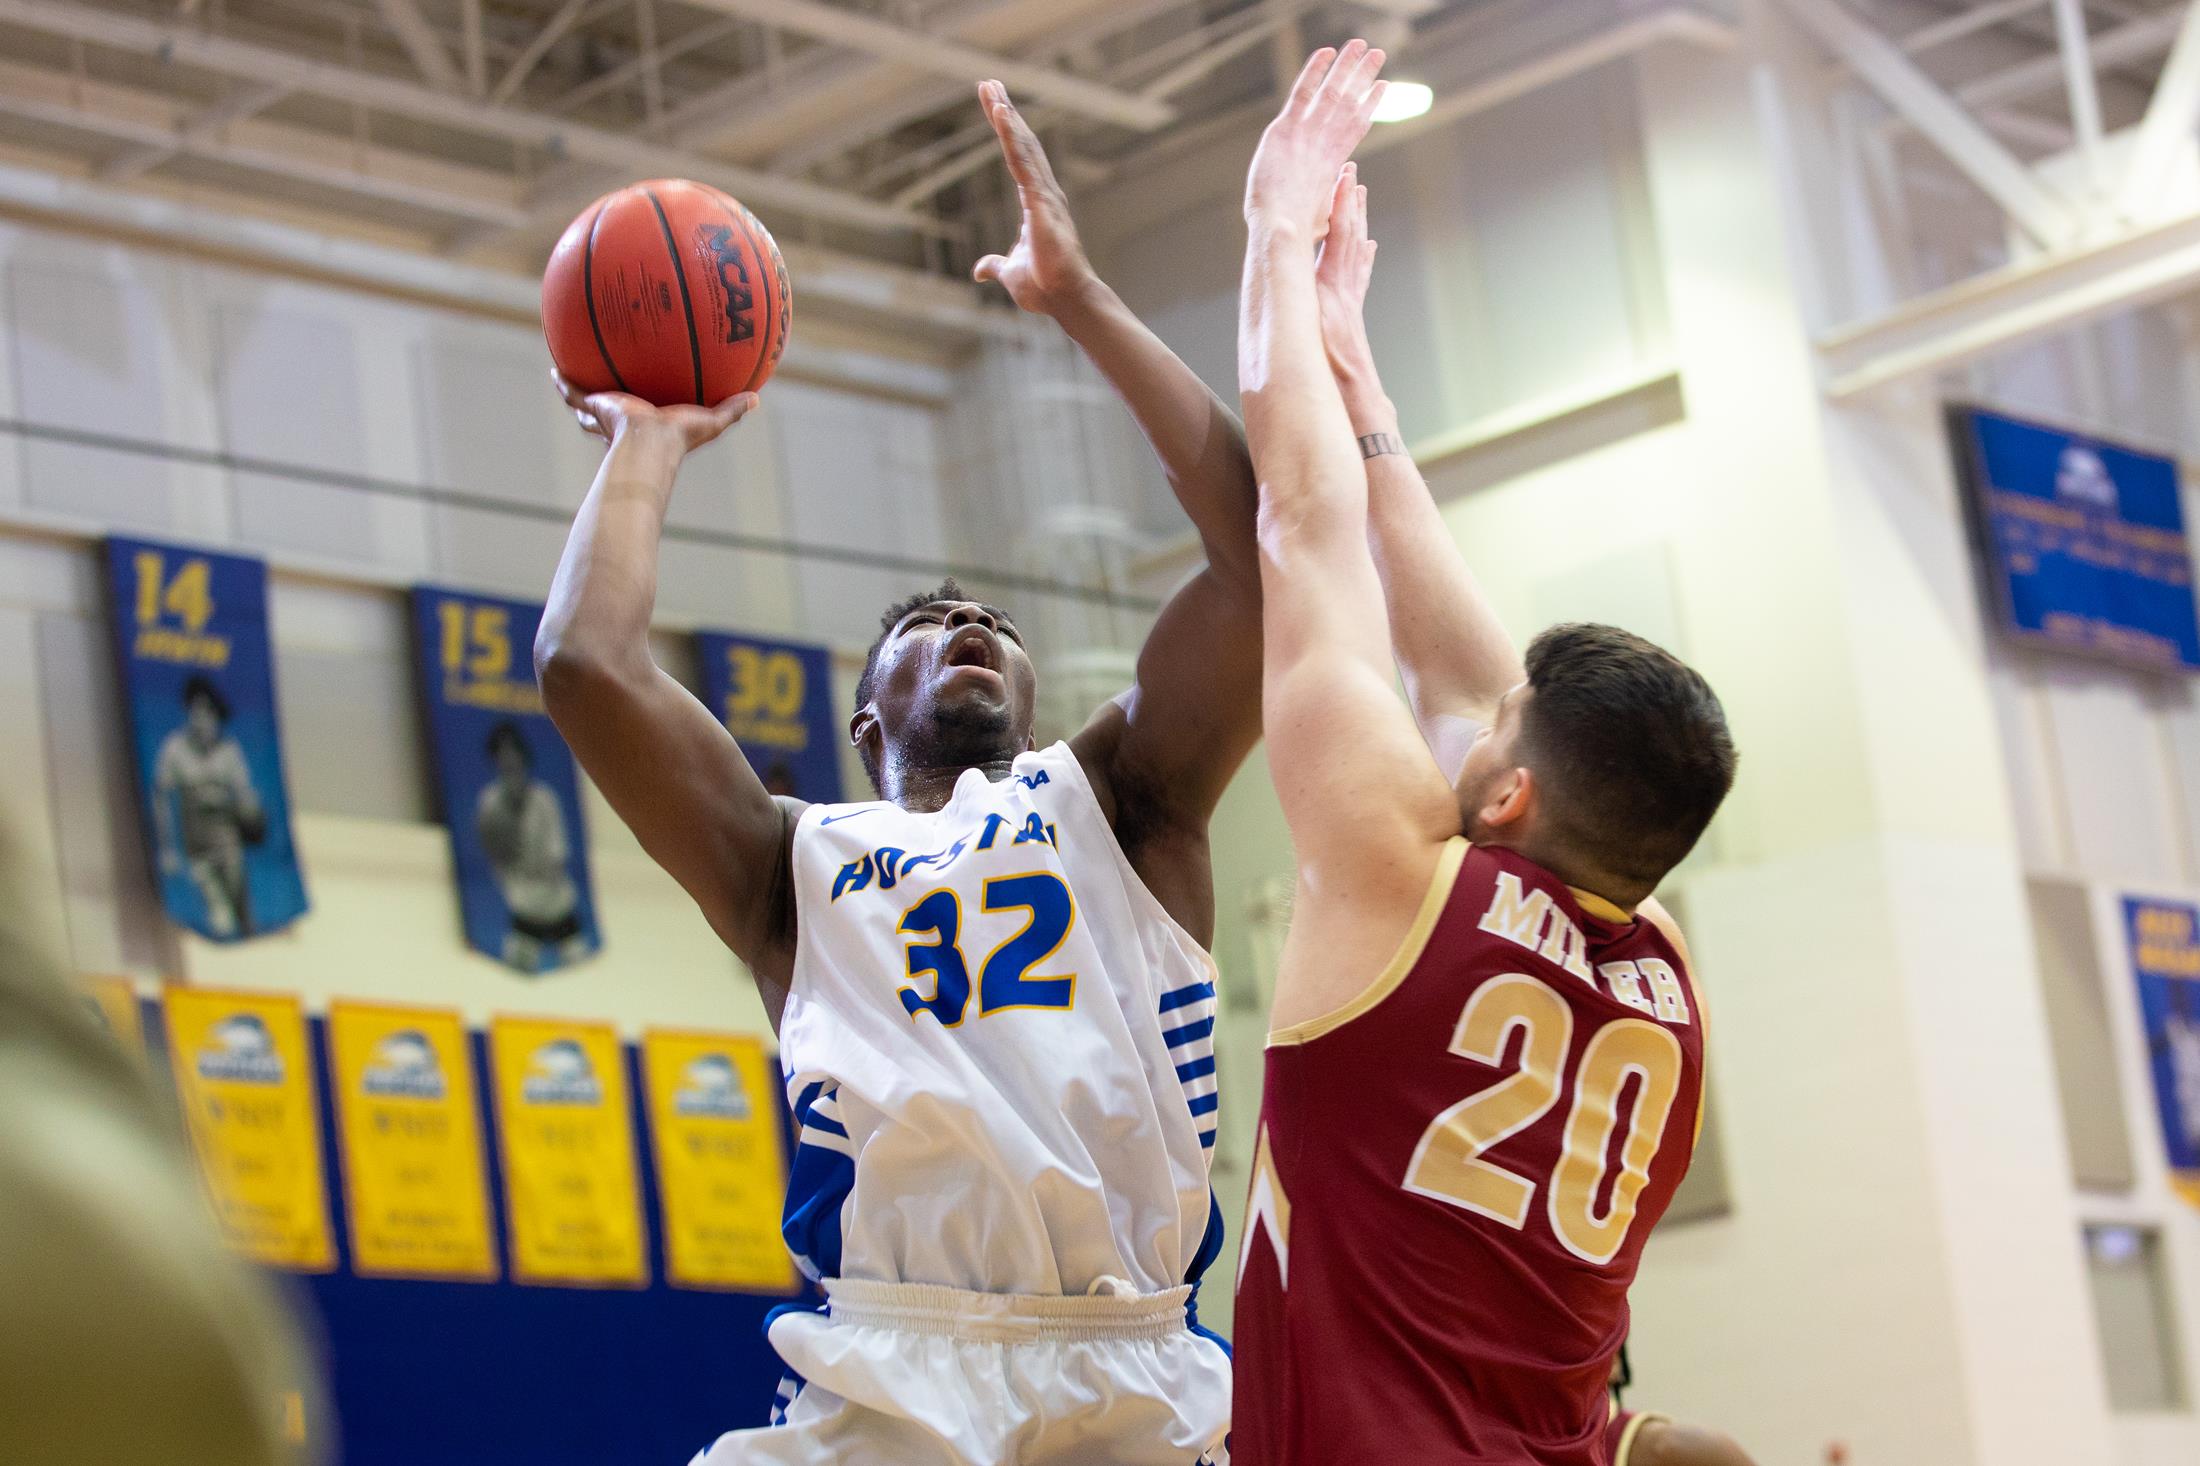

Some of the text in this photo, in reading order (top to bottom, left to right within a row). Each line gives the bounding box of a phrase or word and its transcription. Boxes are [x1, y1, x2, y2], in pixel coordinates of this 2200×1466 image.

[699, 223, 754, 344] NCAA
[135, 552, 214, 632] 14
[438, 601, 512, 675] 15
[727, 646, 806, 718] 30
[1014, 769, 1050, 790] AA
[896, 870, 1077, 1028] 32
[1477, 870, 1690, 1025] MILER
[1401, 972, 1683, 1265] 20
